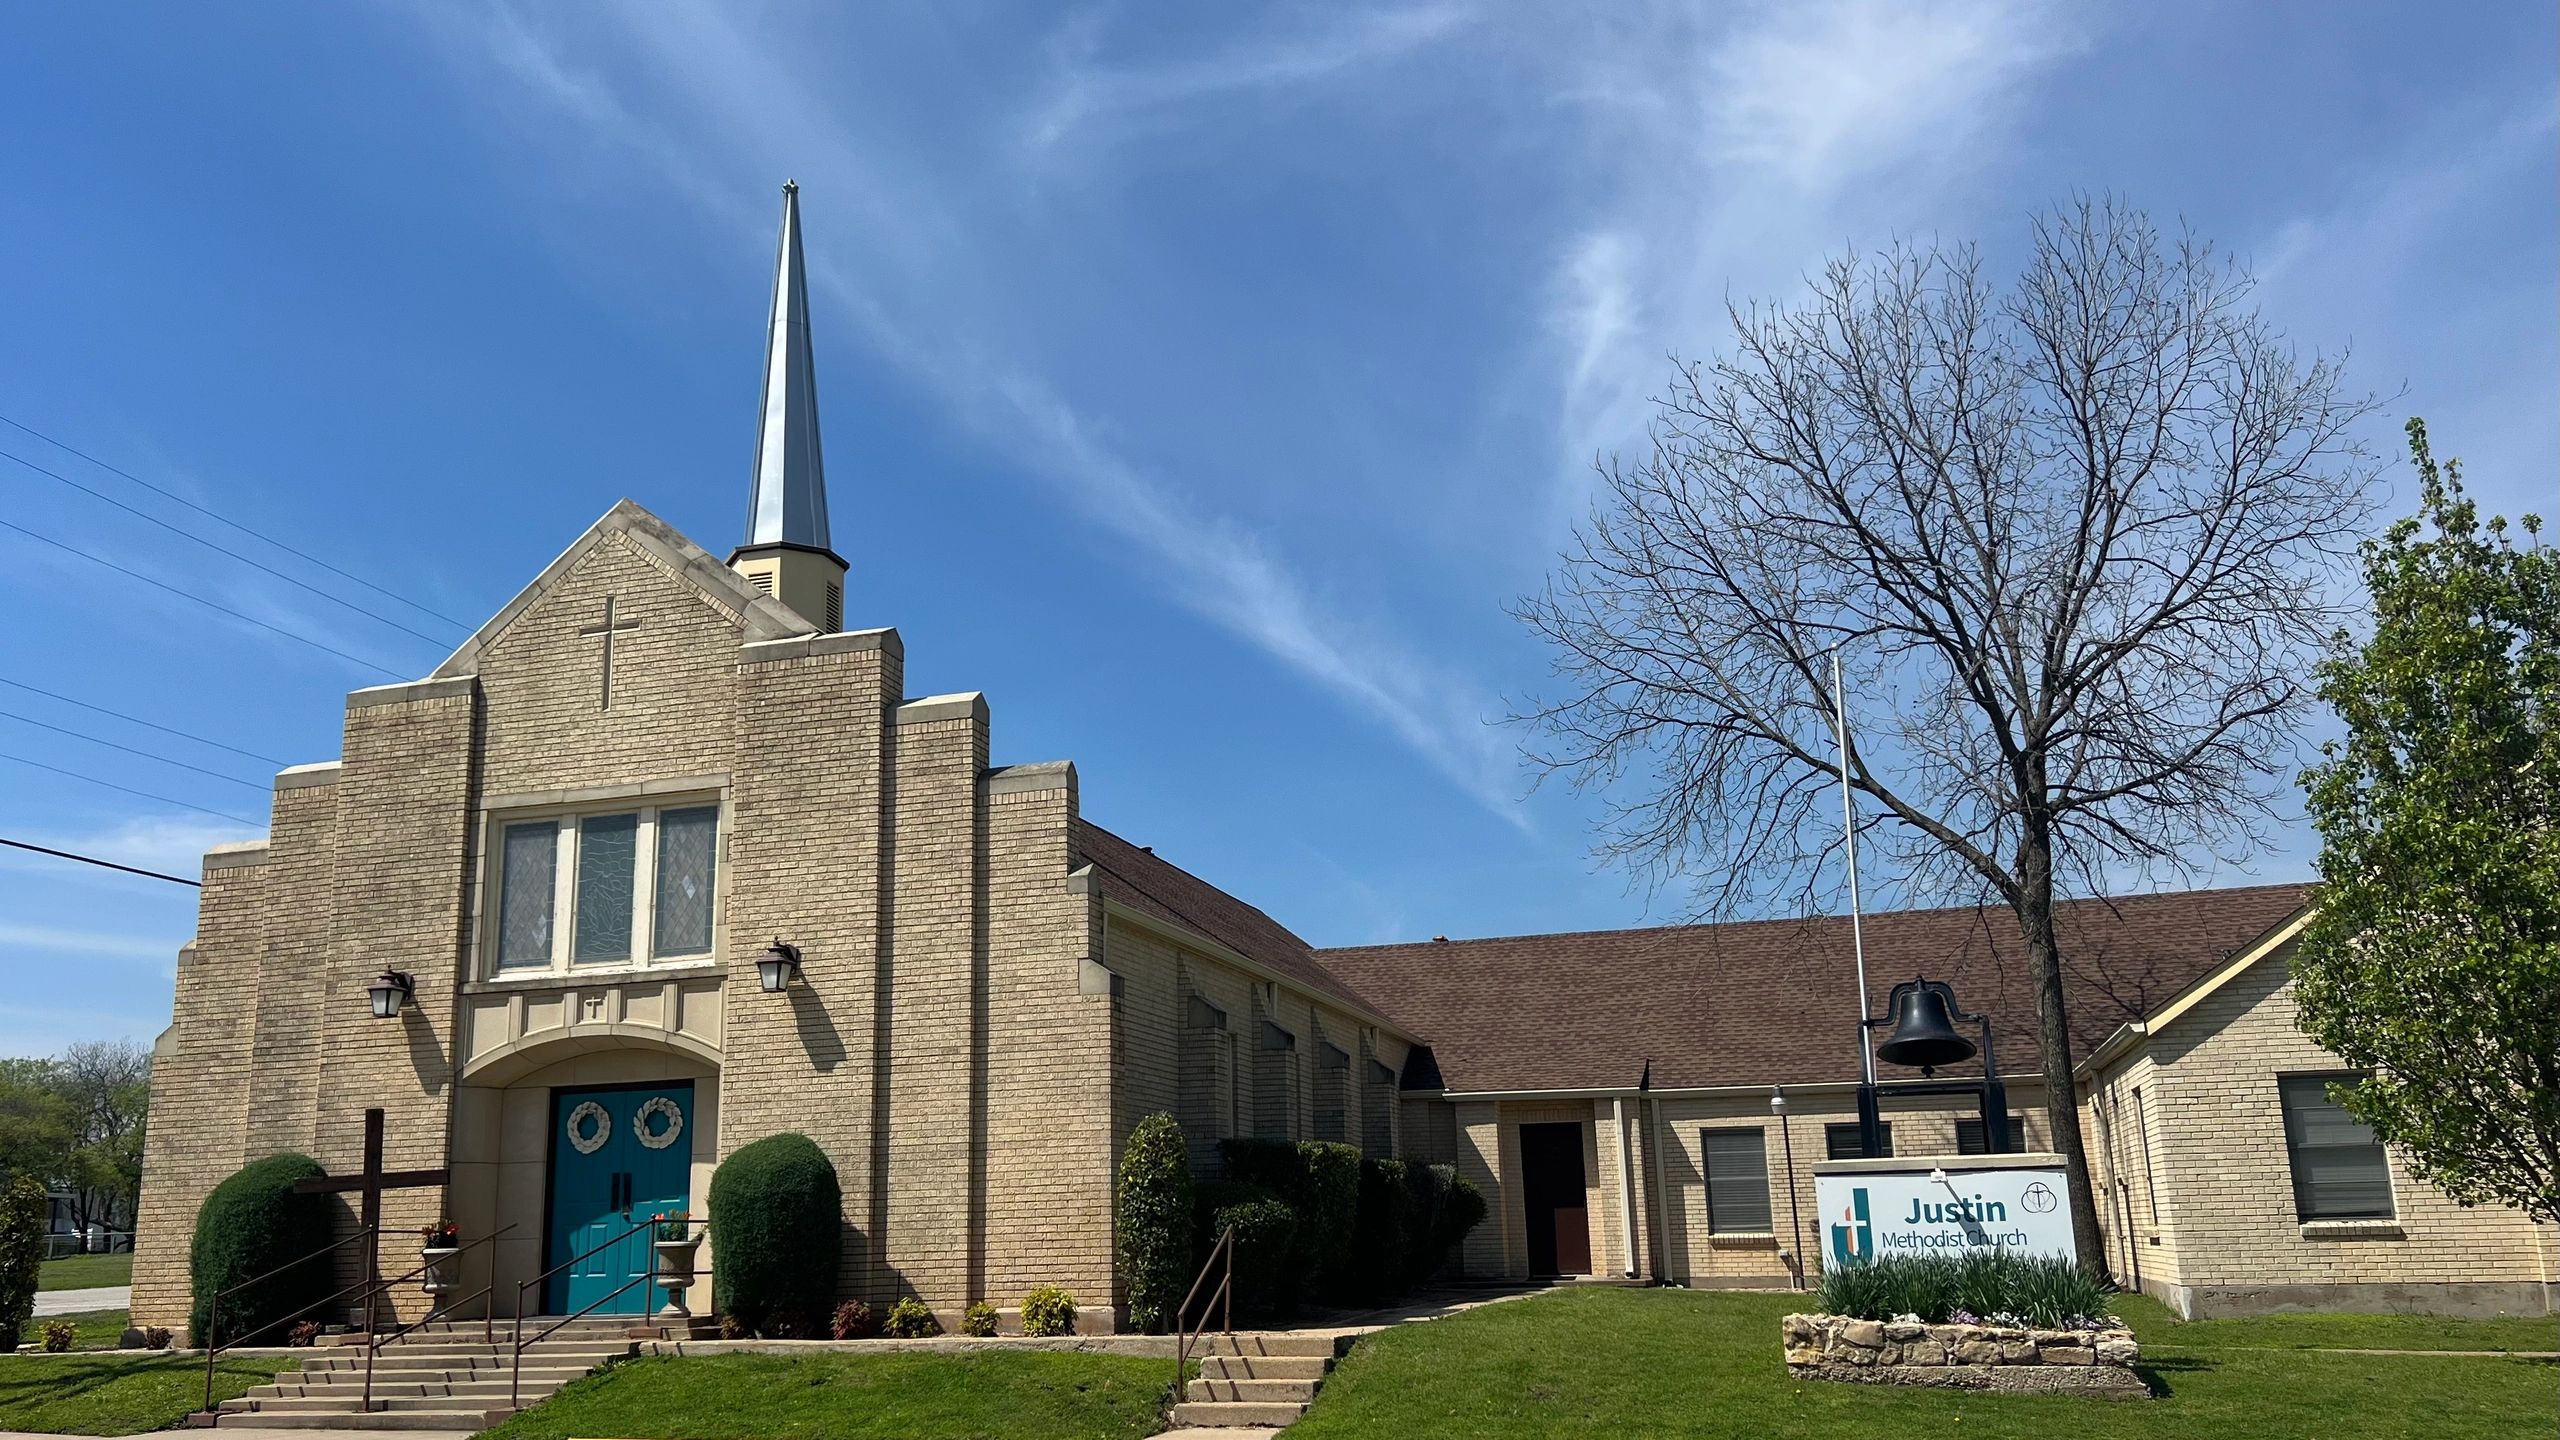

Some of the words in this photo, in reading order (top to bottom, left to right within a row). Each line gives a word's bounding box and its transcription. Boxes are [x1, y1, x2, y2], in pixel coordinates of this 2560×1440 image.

[1904, 1193, 2007, 1225] Justin
[1882, 1229, 1966, 1249] Methodist
[1966, 1227, 2028, 1247] Church
